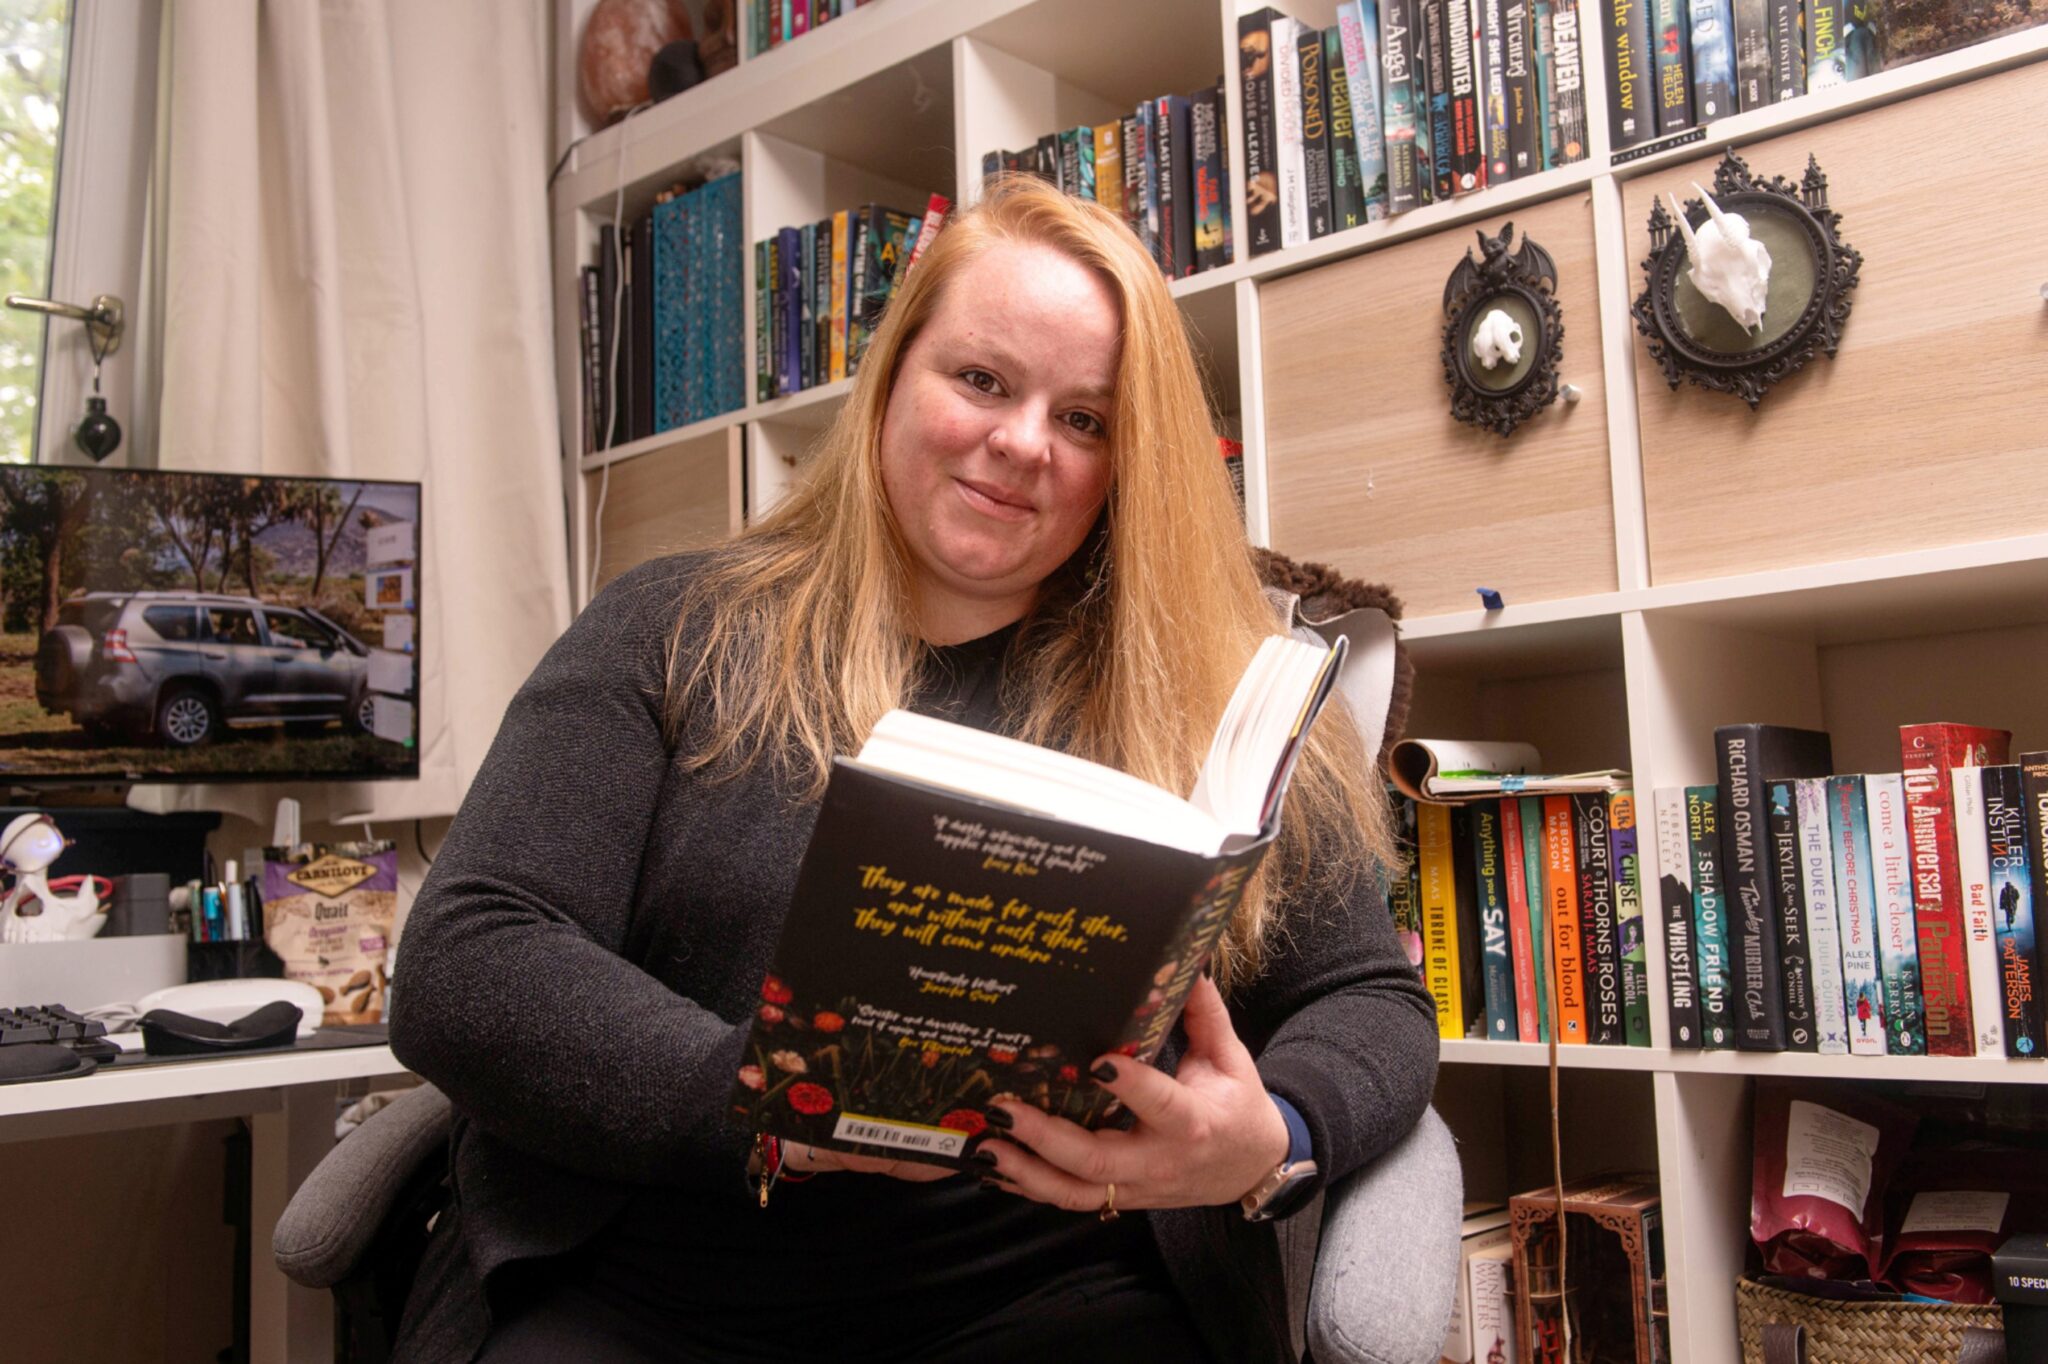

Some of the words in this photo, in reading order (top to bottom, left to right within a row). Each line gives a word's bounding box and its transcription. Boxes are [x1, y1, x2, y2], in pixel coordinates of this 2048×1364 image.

[1391, 7, 1401, 23] The
[1778, 5, 1789, 33] KATE
[1814, 7, 1835, 62] FINCH
[1341, 16, 1359, 76] DOUGLAS
[1383, 24, 1410, 83] Angel
[1448, 0, 1471, 97] MINDHUNTER
[1488, 39, 1501, 66] SHE
[1506, 3, 1527, 77] WITCHERY
[1553, 11, 1580, 93] DEAVER
[1780, 38, 1791, 81] FOSTER
[1280, 45, 1292, 97] DIVIDED
[1300, 43, 1325, 139] POISONED
[1490, 67, 1503, 95] LIED
[1616, 33, 1638, 110] window
[1663, 66, 1676, 108] FIELDS
[1673, 64, 1685, 105] HELEN
[1331, 67, 1352, 138] Deaver
[1159, 117, 1170, 136] HIS
[1159, 138, 1171, 168] LAST
[1160, 173, 1172, 201] WIFE
[1688, 794, 1702, 841] NORTH
[1703, 801, 1716, 833] ALEX
[1879, 791, 1892, 835] come
[1479, 812, 1497, 876] Anything
[1549, 816, 1560, 869] MASSON
[1557, 811, 1571, 872] DEBORAH
[1589, 806, 1607, 869] COURT
[1660, 809, 1671, 864] NETLEY
[1670, 803, 1682, 870] REBECCA
[1734, 811, 1755, 872] OSMAN
[1774, 832, 1795, 877] JEKYLL
[1807, 824, 1821, 851] THE
[1843, 830, 1856, 876] BEFORE
[1884, 841, 1894, 849] a
[1987, 797, 2010, 878] INSTINCT
[2004, 807, 2024, 866] KILLER
[296, 865, 368, 881] CARNILOVE
[1429, 867, 1441, 900] MAAS
[1486, 879, 1496, 894] you
[1618, 855, 1638, 907] CURSE
[1810, 857, 1825, 896] DUKE
[1885, 856, 1904, 896] little
[1970, 883, 1985, 906] Bad
[912, 884, 941, 900] are
[947, 892, 994, 912] made
[1001, 898, 1031, 920] for
[1035, 907, 1076, 932] each
[1081, 915, 1128, 943] other,
[1488, 895, 1497, 907] do
[1556, 887, 1569, 916] out
[1582, 874, 1595, 919] SARAH
[1593, 878, 1612, 954] THORNS
[1672, 905, 1682, 918] THE
[1698, 860, 1718, 937] SHADOW
[1847, 879, 1862, 944] CHRISTMAS
[887, 902, 924, 918] and
[927, 908, 999, 934] without
[996, 921, 1036, 943] each
[1041, 929, 1088, 953] other,
[902, 923, 940, 946] will
[941, 933, 985, 951] come
[990, 942, 1052, 963] undone
[1430, 906, 1446, 950] THRONE
[1483, 909, 1507, 957] SAY
[1559, 924, 1574, 950] for
[1784, 908, 1800, 945] SEEK
[1889, 902, 1906, 951] closer
[1972, 910, 1989, 942] Faith
[1433, 957, 1448, 970] OF
[1585, 935, 1598, 973] MAAS
[1668, 920, 1692, 1008] WHISTLING
[1743, 935, 1763, 989] MURDER
[1847, 962, 1871, 970] PINE
[1434, 977, 1450, 1013] GLASS
[1561, 958, 1579, 1008] blood
[1599, 962, 1617, 1025] ROSES
[1636, 974, 1648, 995] ELLE
[1704, 943, 1724, 1013] FRIEND
[1821, 979, 1835, 1022] QUINN
[1888, 973, 1901, 1018] PERRY
[1902, 970, 1916, 1020] KAREN
[1918, 921, 1950, 1036] Patterson
[2003, 938, 2021, 1019] PATTERSON
[2017, 955, 2032, 1002] JAMES
[1744, 990, 1765, 1020] Club
[1475, 1262, 1489, 1330] WALTERS
[1487, 1262, 1501, 1330] MINETTE
[2008, 1276, 2020, 1288] 10
